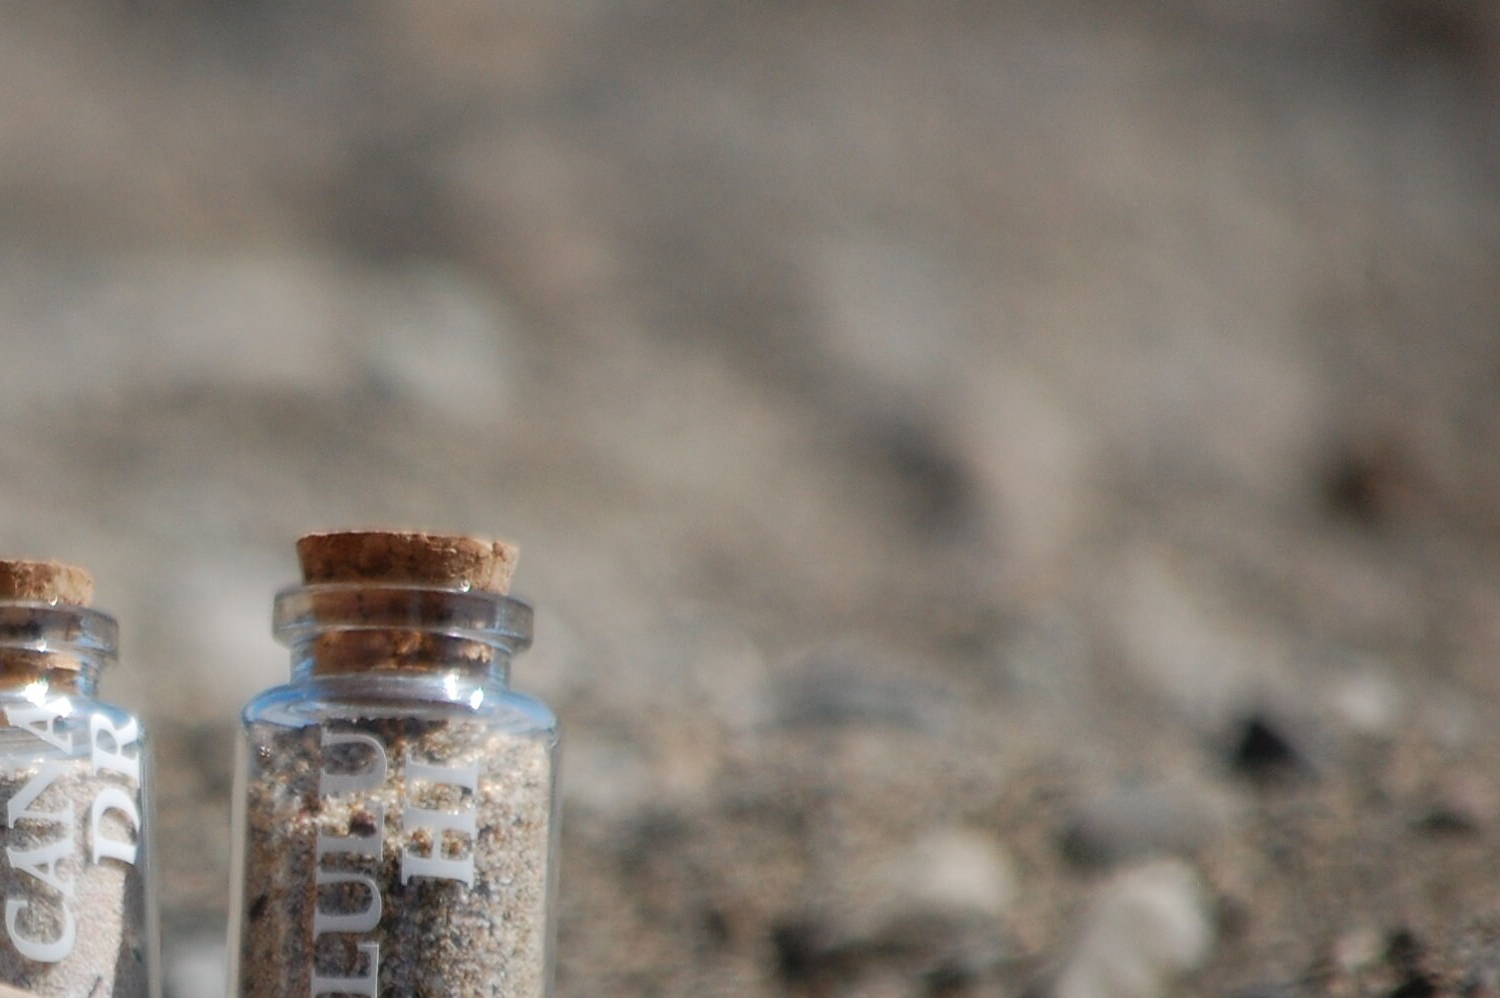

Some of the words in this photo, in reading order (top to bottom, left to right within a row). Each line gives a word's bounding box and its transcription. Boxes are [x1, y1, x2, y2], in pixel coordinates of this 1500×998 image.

[4, 698, 76, 963] CANA
[90, 713, 141, 865] DR
[402, 753, 478, 889] HI
